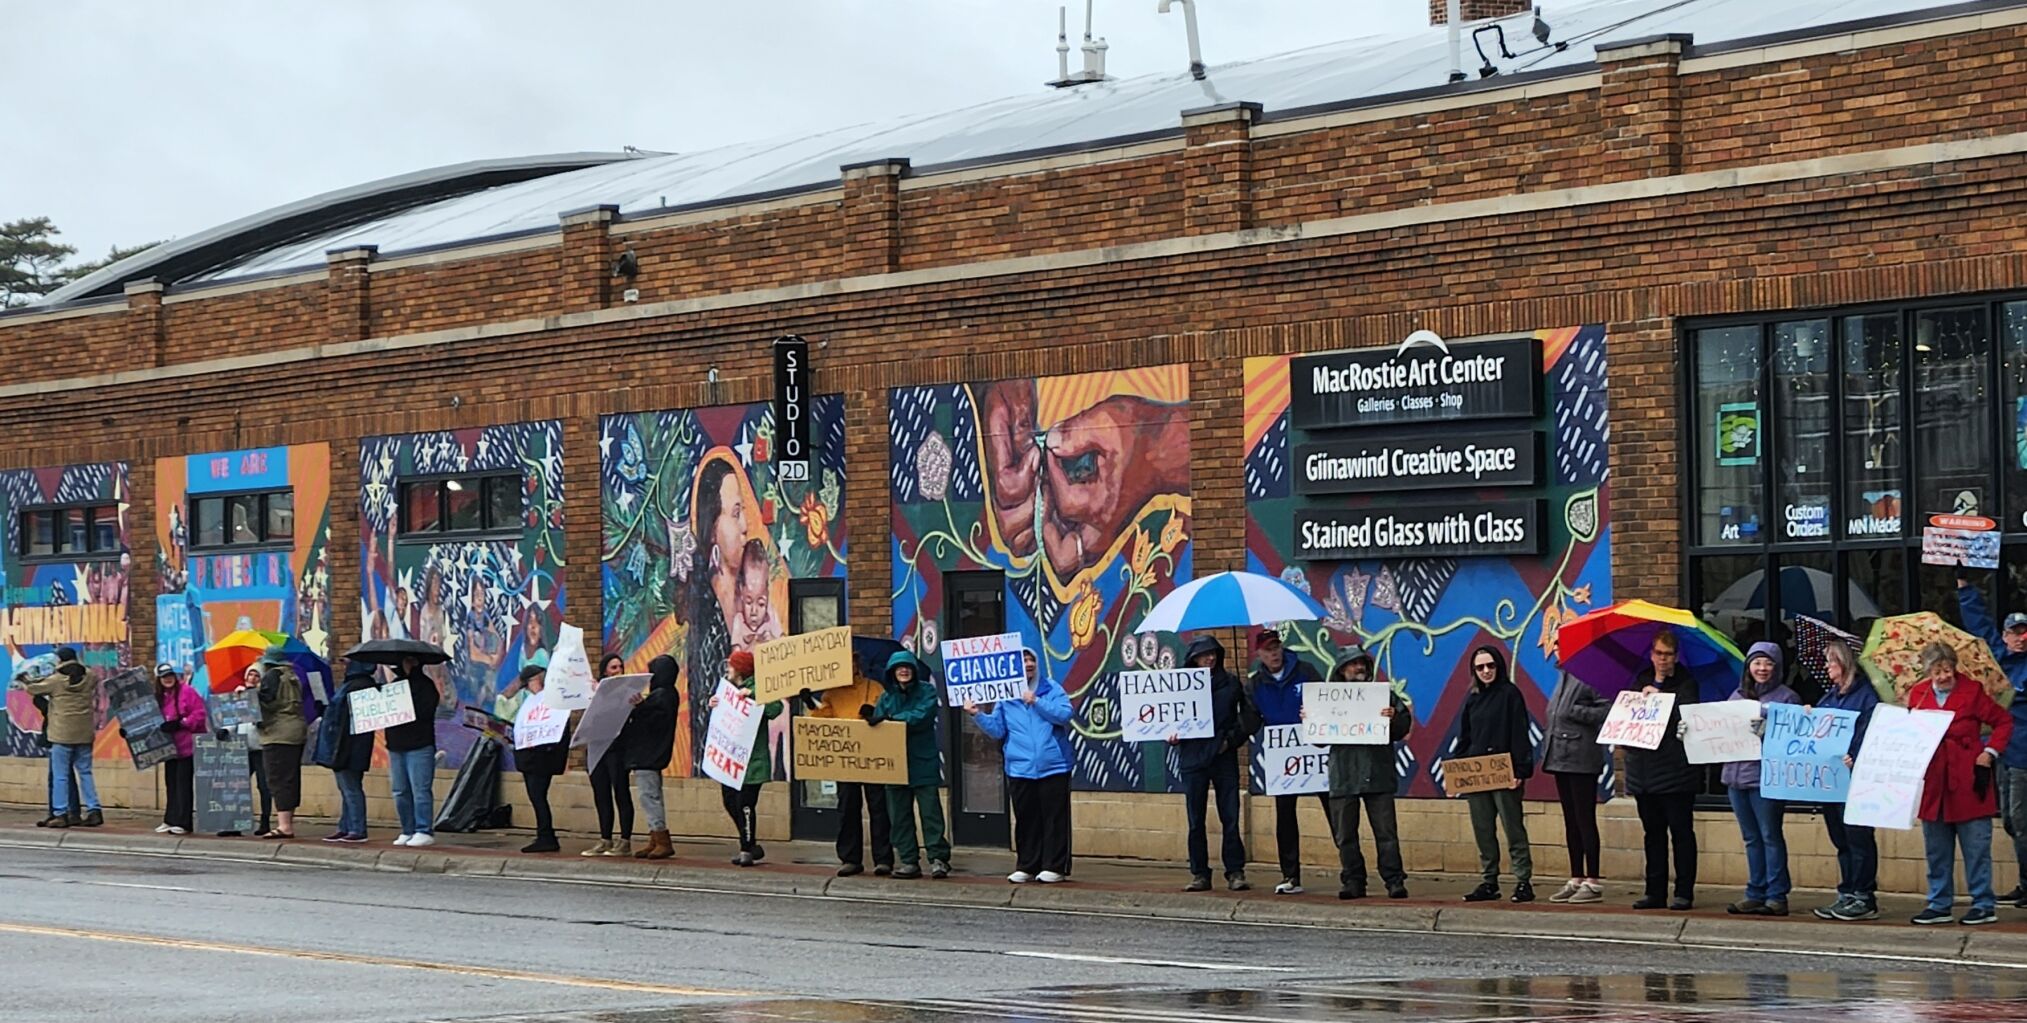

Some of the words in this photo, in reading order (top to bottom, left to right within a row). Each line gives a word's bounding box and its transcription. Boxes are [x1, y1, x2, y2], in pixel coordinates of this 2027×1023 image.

[1313, 358, 1407, 395] MacRostie
[1408, 359, 1438, 388] Art
[1440, 354, 1505, 384] Center
[786, 350, 800, 456] STUDIO
[1357, 396, 1396, 413] Galleries
[1401, 394, 1434, 411] Classes
[1440, 393, 1463, 410] Shop
[211, 457, 229, 479] WE
[241, 452, 268, 475] ARE
[782, 463, 805, 479] 2D
[1306, 448, 1388, 481] Giinawind
[1391, 446, 1462, 475] Creative
[1465, 445, 1516, 479] Space
[1785, 504, 1824, 520] Custom
[1301, 517, 1371, 550] Stained
[1374, 516, 1425, 547] Glass
[1427, 513, 1470, 544] with
[1474, 512, 1524, 543] Class
[1722, 523, 1740, 540] Art
[1786, 520, 1823, 537] Orders
[1848, 516, 1868, 535] MN
[1868, 515, 1901, 533] Made
[1938, 517, 1987, 528] WARNING
[760, 641, 798, 666] MAYDAY
[803, 630, 849, 656] MAYDAY
[765, 670, 796, 694] DUMP
[800, 662, 840, 686] TRUMP
[947, 654, 1019, 683] CHANGE
[352, 682, 406, 702] PROTECT
[953, 680, 1024, 704] PRESIDENT
[1123, 670, 1205, 695] HANDS
[724, 685, 752, 718] HATE
[1318, 688, 1366, 701] HONK
[353, 700, 398, 718] PUBLIC
[1631, 707, 1660, 721] YOUR
[356, 711, 414, 732] EDUCATION
[798, 723, 851, 739] MAYDAY!
[1308, 723, 1388, 737] DEMOCRACY
[1771, 709, 1816, 740] HANDS
[808, 739, 861, 754] MAYDAY!
[705, 744, 745, 780] GREAT
[797, 754, 834, 769] DUMP
[839, 756, 895, 771] TRUMP!!
[1763, 758, 1840, 790] DEMOCRACY
